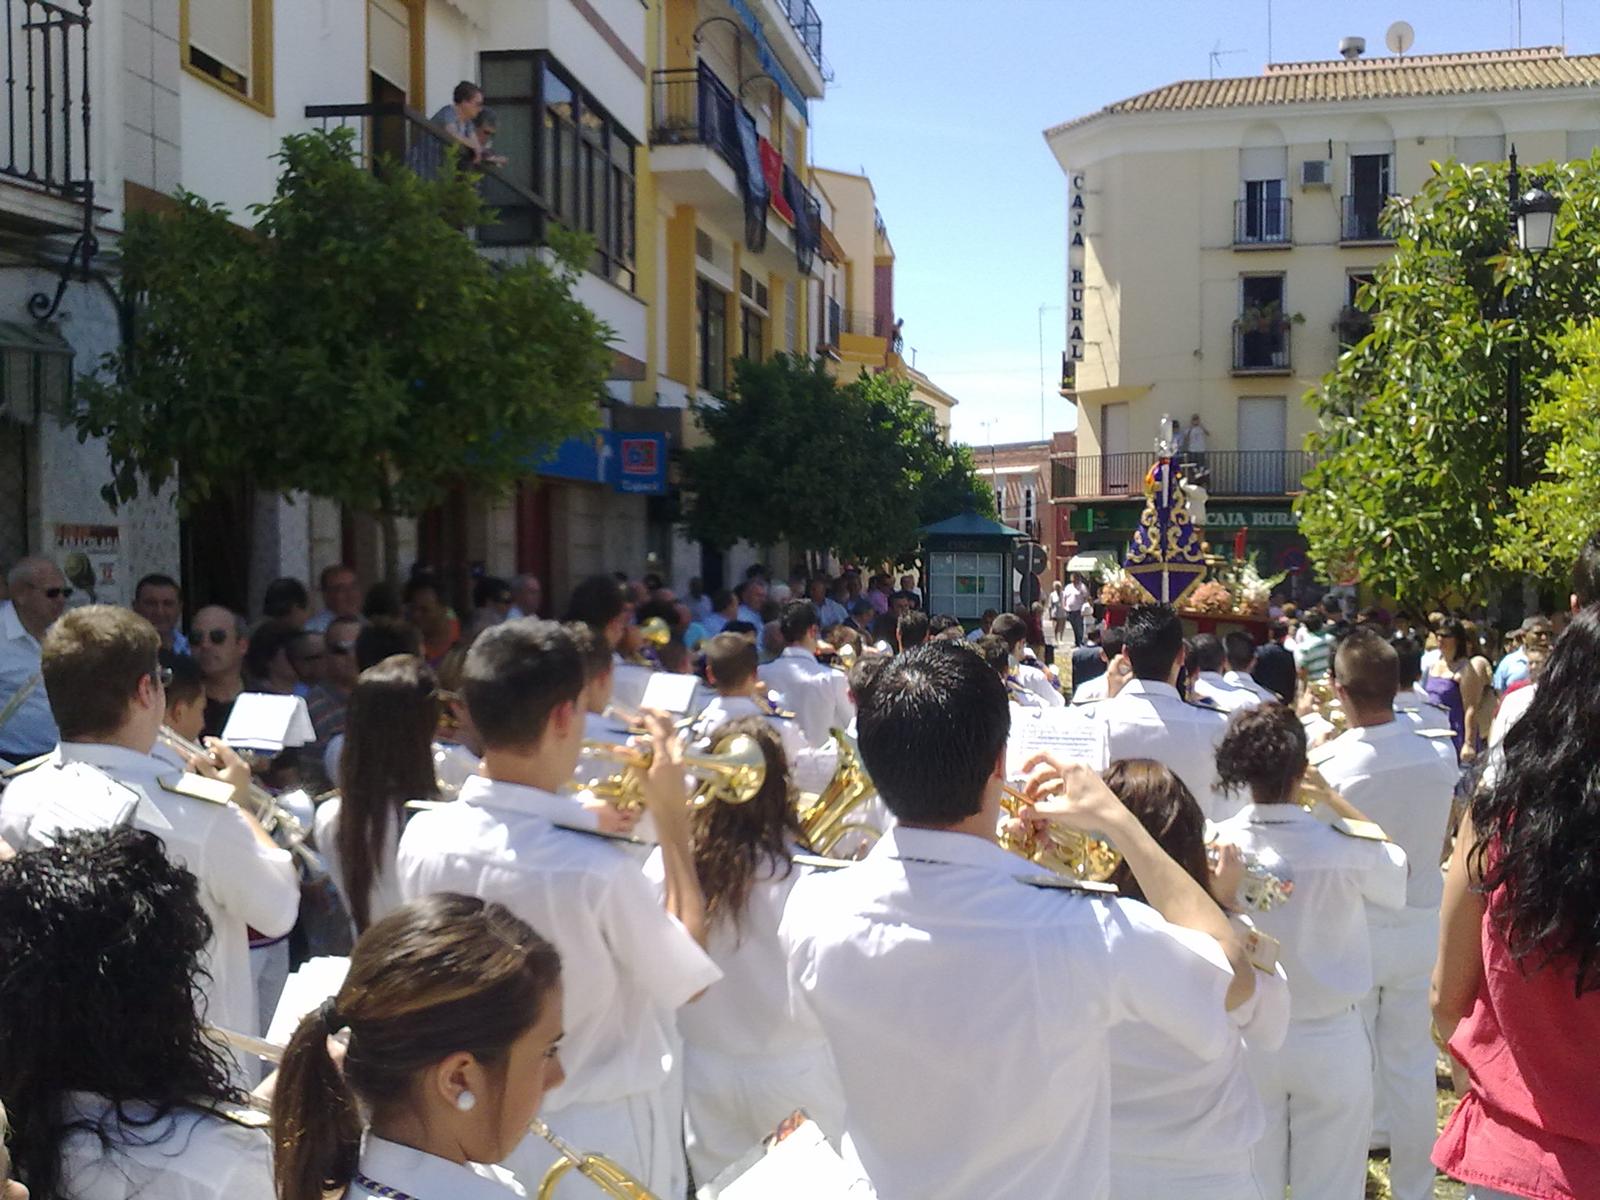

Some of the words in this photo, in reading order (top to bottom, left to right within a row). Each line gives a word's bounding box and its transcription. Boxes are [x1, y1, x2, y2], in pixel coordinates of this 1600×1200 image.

[1072, 175, 1084, 246] CAJA
[1071, 270, 1083, 359] RURAL
[1206, 512, 1247, 526] CAJA
